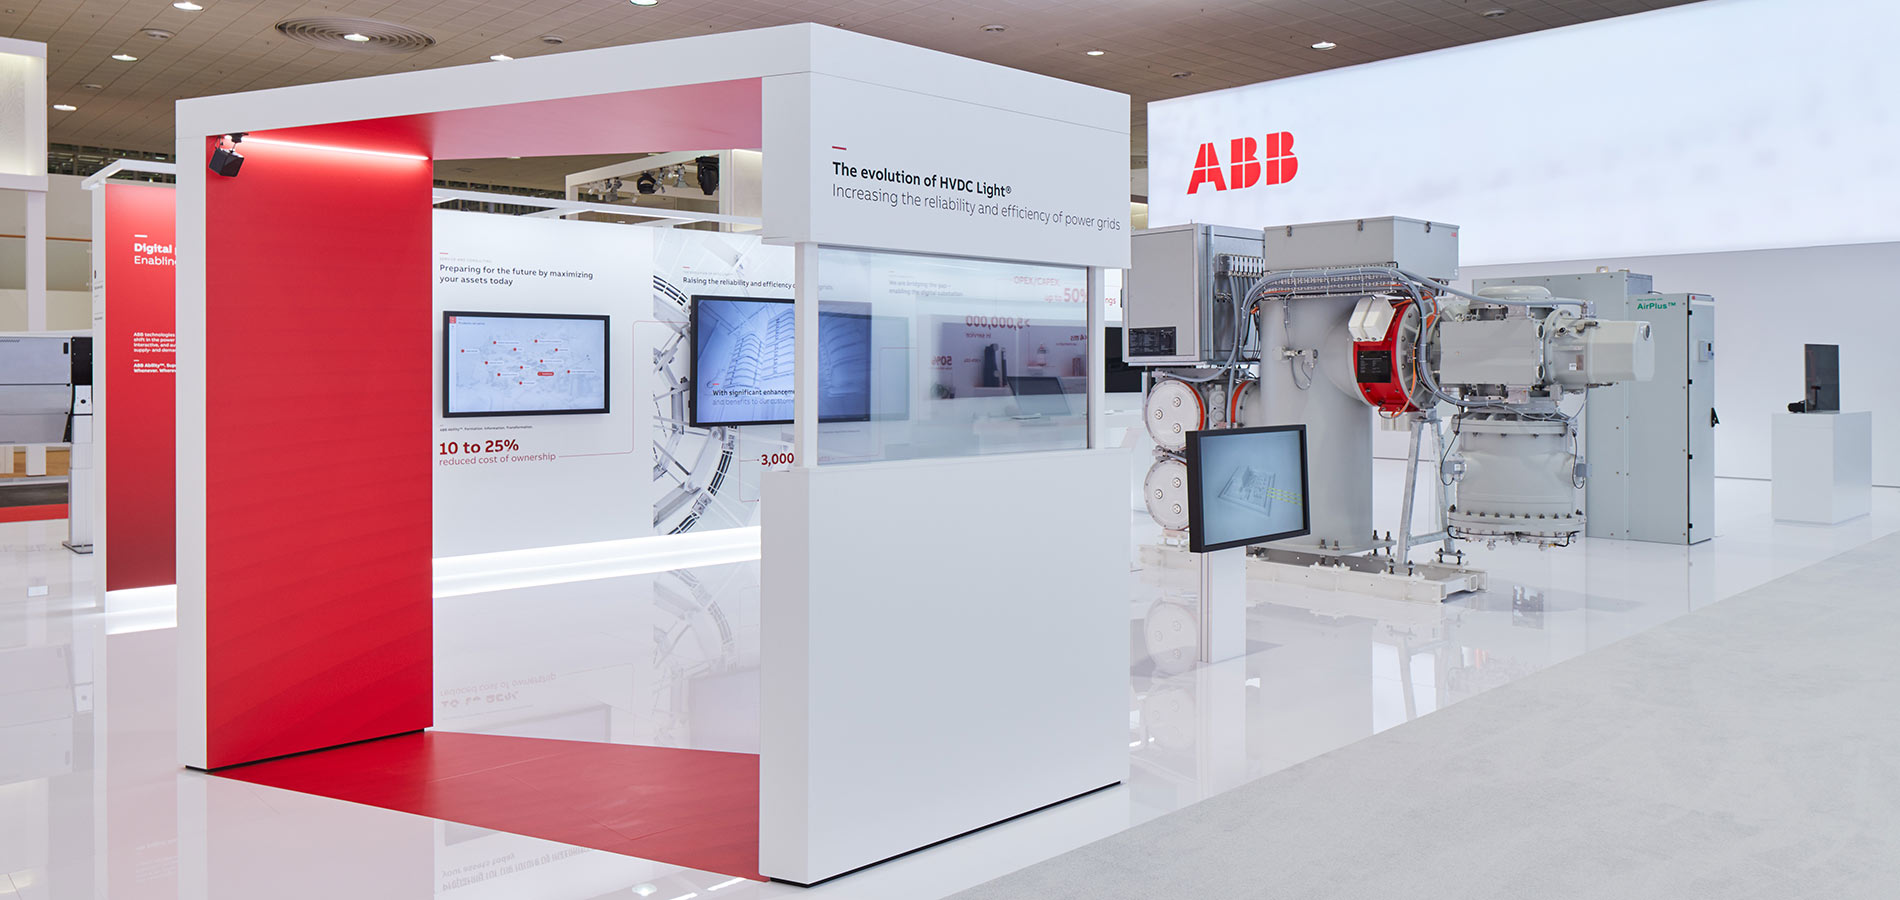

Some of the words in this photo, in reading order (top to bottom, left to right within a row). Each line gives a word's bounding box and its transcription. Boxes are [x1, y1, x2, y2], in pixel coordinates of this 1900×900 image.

[1187, 131, 1298, 195] ABB
[833, 162, 857, 177] The
[861, 168, 920, 185] evolution
[924, 175, 936, 187] of
[940, 177, 974, 192] HVDC
[833, 184, 898, 207] Increasing
[901, 193, 921, 206] the
[924, 196, 976, 216] reliability
[978, 204, 998, 216] and
[1001, 205, 1050, 224] efficiency
[1053, 211, 1062, 222] of
[1066, 214, 1095, 226] power
[1097, 217, 1120, 230] grids
[134, 243, 172, 254] Digital
[134, 256, 177, 266] Enablin
[440, 264, 480, 274] Preparing
[483, 266, 494, 274] for
[512, 268, 537, 276] future
[539, 269, 548, 278] by
[550, 270, 594, 280] maximizing
[490, 278, 513, 286] today
[683, 277, 706, 285] Raising
[720, 280, 748, 288] reliability
[440, 442, 458, 455] 10
[463, 442, 480, 454] to
[485, 439, 519, 453] 25%
[440, 456, 476, 466] reduced
[500, 454, 510, 462] of
[511, 452, 556, 462] ownership
[761, 453, 794, 467] 3,000
